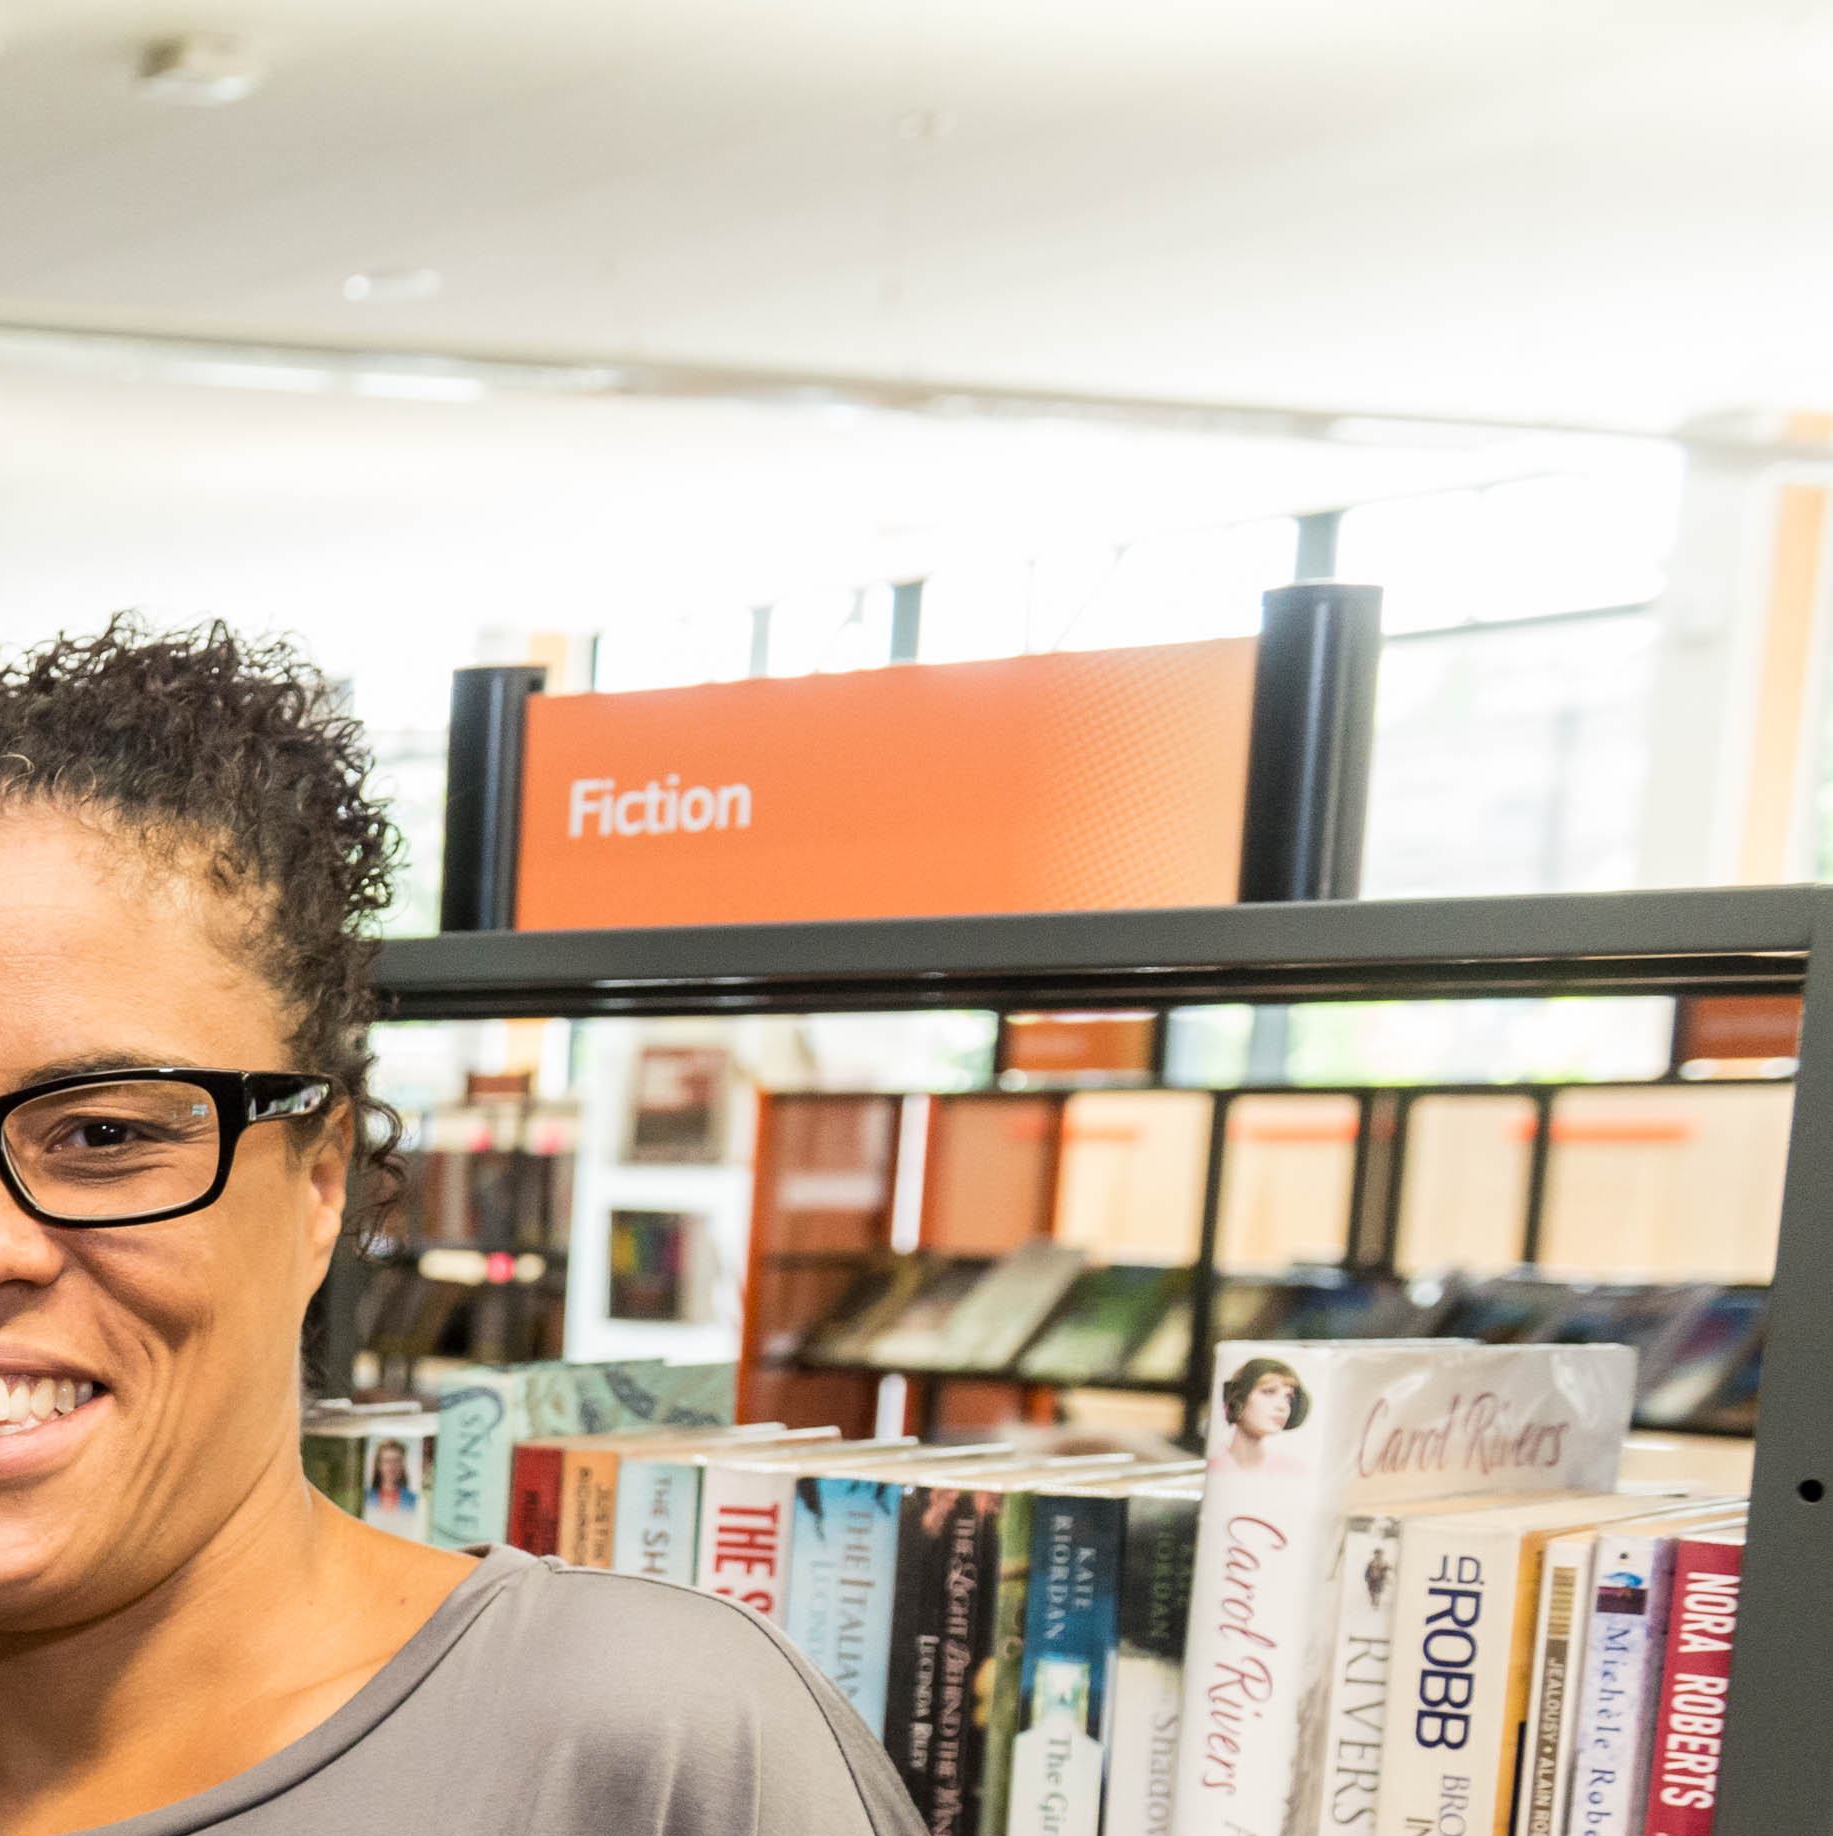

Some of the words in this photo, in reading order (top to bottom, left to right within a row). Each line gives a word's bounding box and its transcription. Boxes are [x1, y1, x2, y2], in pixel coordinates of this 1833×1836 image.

[567, 775, 752, 838] Fiction
[454, 1414, 482, 1531] SNAKE
[1357, 1394, 1462, 1479] Carol
[1465, 1391, 1570, 1475] Rivers
[714, 1503, 781, 1576] THE
[1045, 1515, 1074, 1640] RIORDAN
[1075, 1547, 1098, 1610] KATE
[1220, 1514, 1288, 1650] Carol
[1428, 1553, 1485, 1586] J.D.
[1678, 1571, 1741, 1653] NORA
[1415, 1586, 1482, 1751] ROBB
[1541, 1656, 1565, 1744] JEALOUSY
[1594, 1625, 1630, 1750] Michèle
[1043, 1736, 1072, 1785] The
[1202, 1655, 1274, 1798] Rivers
[1332, 1635, 1391, 1828] RIVERS
[1660, 1673, 1730, 1810] ROBERTS
[1534, 1758, 1559, 1805] ALAIN
